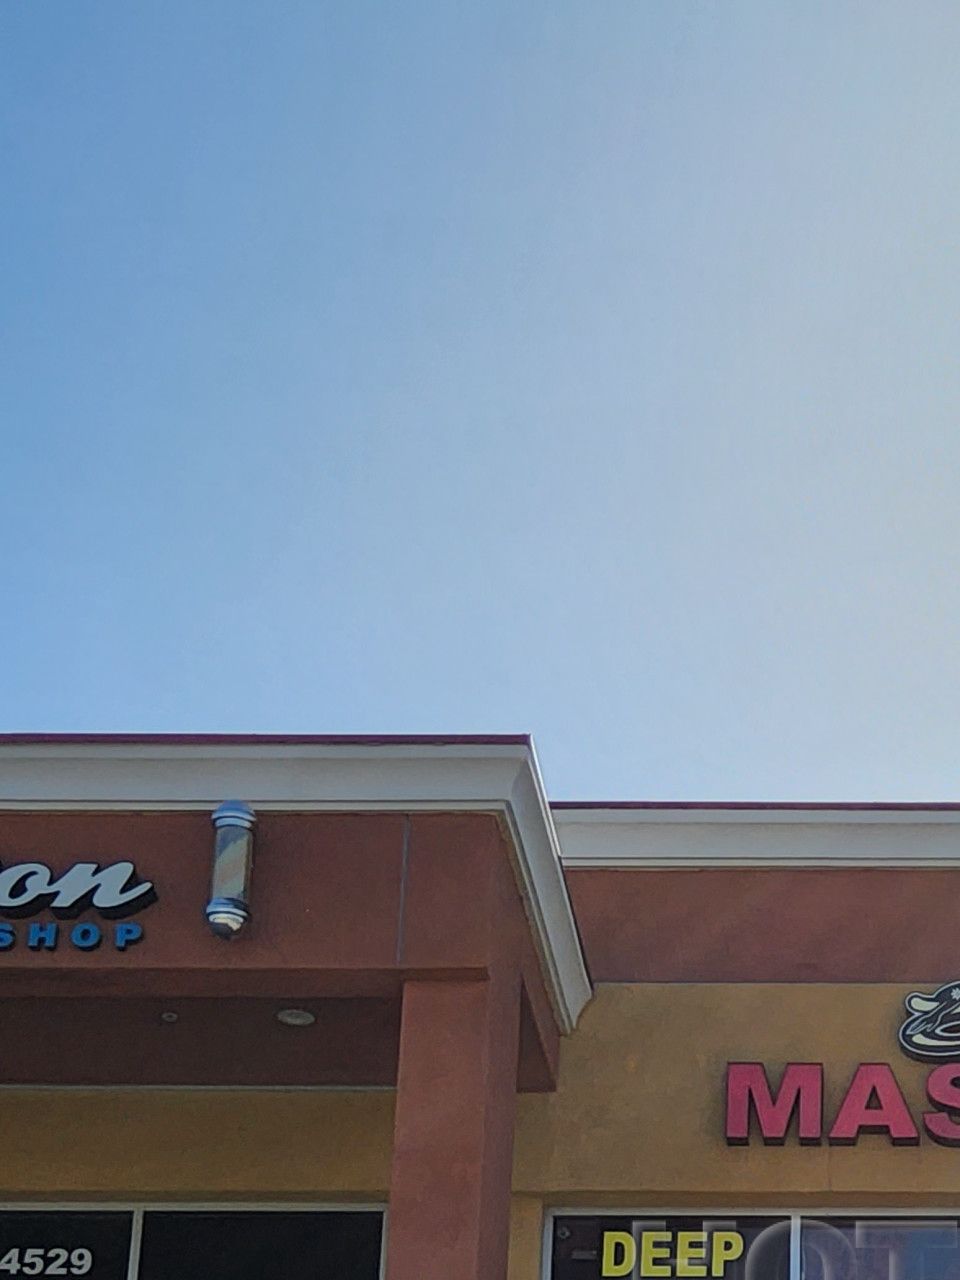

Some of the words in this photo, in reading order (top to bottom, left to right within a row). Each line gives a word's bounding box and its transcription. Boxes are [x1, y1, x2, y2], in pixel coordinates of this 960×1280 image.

[0, 922, 143, 948] SHOP
[0, 1248, 93, 1275] 4529
[601, 1231, 744, 1277] DEEP
